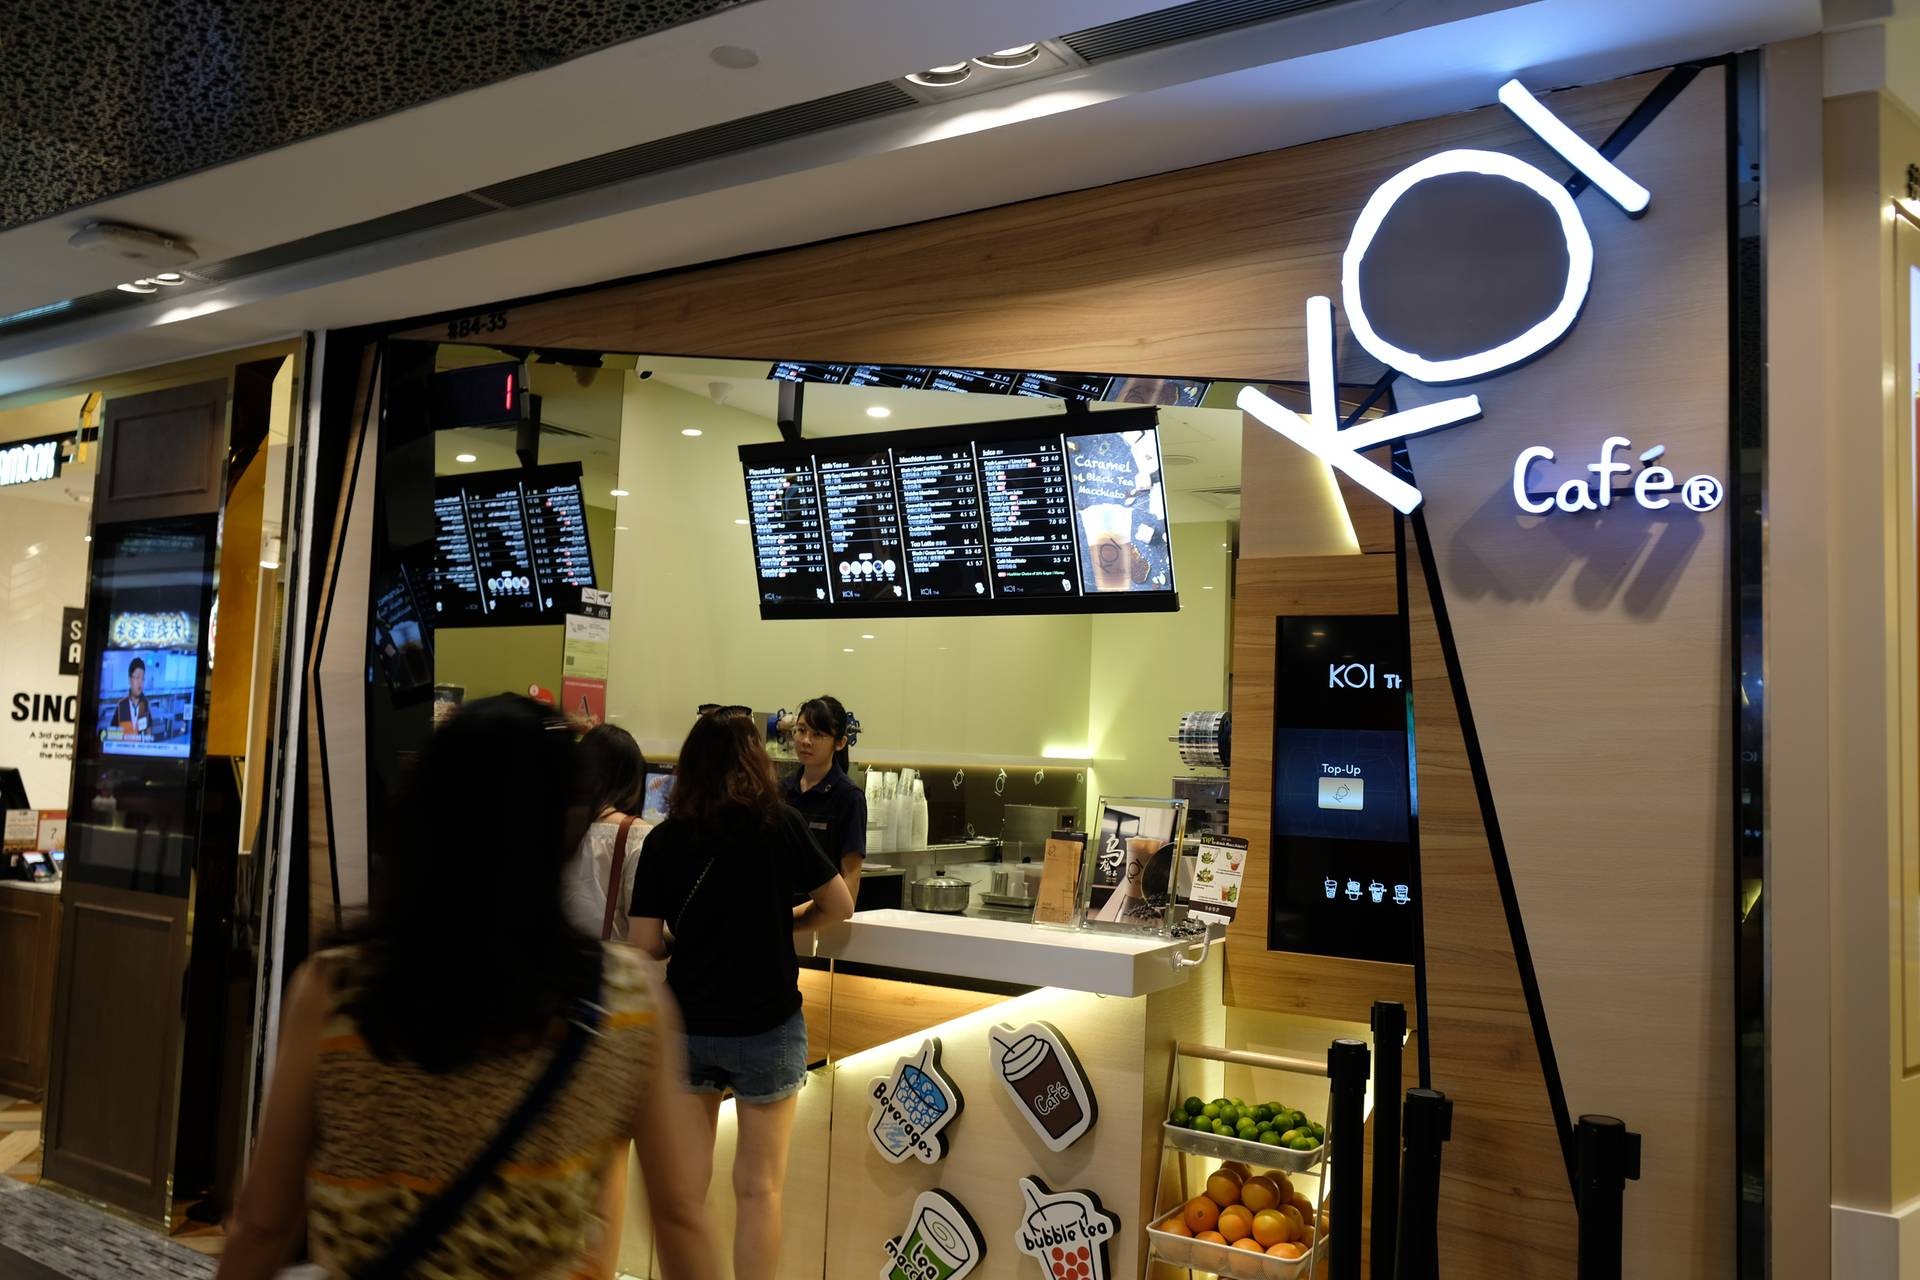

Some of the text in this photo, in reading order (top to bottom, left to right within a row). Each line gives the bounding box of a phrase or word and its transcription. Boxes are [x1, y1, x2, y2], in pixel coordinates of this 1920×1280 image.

[1237, 79, 1650, 514] KOI
[448, 311, 507, 339] #B4-35
[1074, 455, 1132, 472] Caramel
[1087, 472, 1134, 488] Black Tea
[1330, 664, 1375, 689] KOI
[1322, 764, 1362, 776] Top-Up
[1332, 784, 1350, 804] KOI
[1034, 1082, 1070, 1116] Café
[873, 1082, 932, 1158] Beverages
[1023, 1219, 1108, 1251] bubble tea
